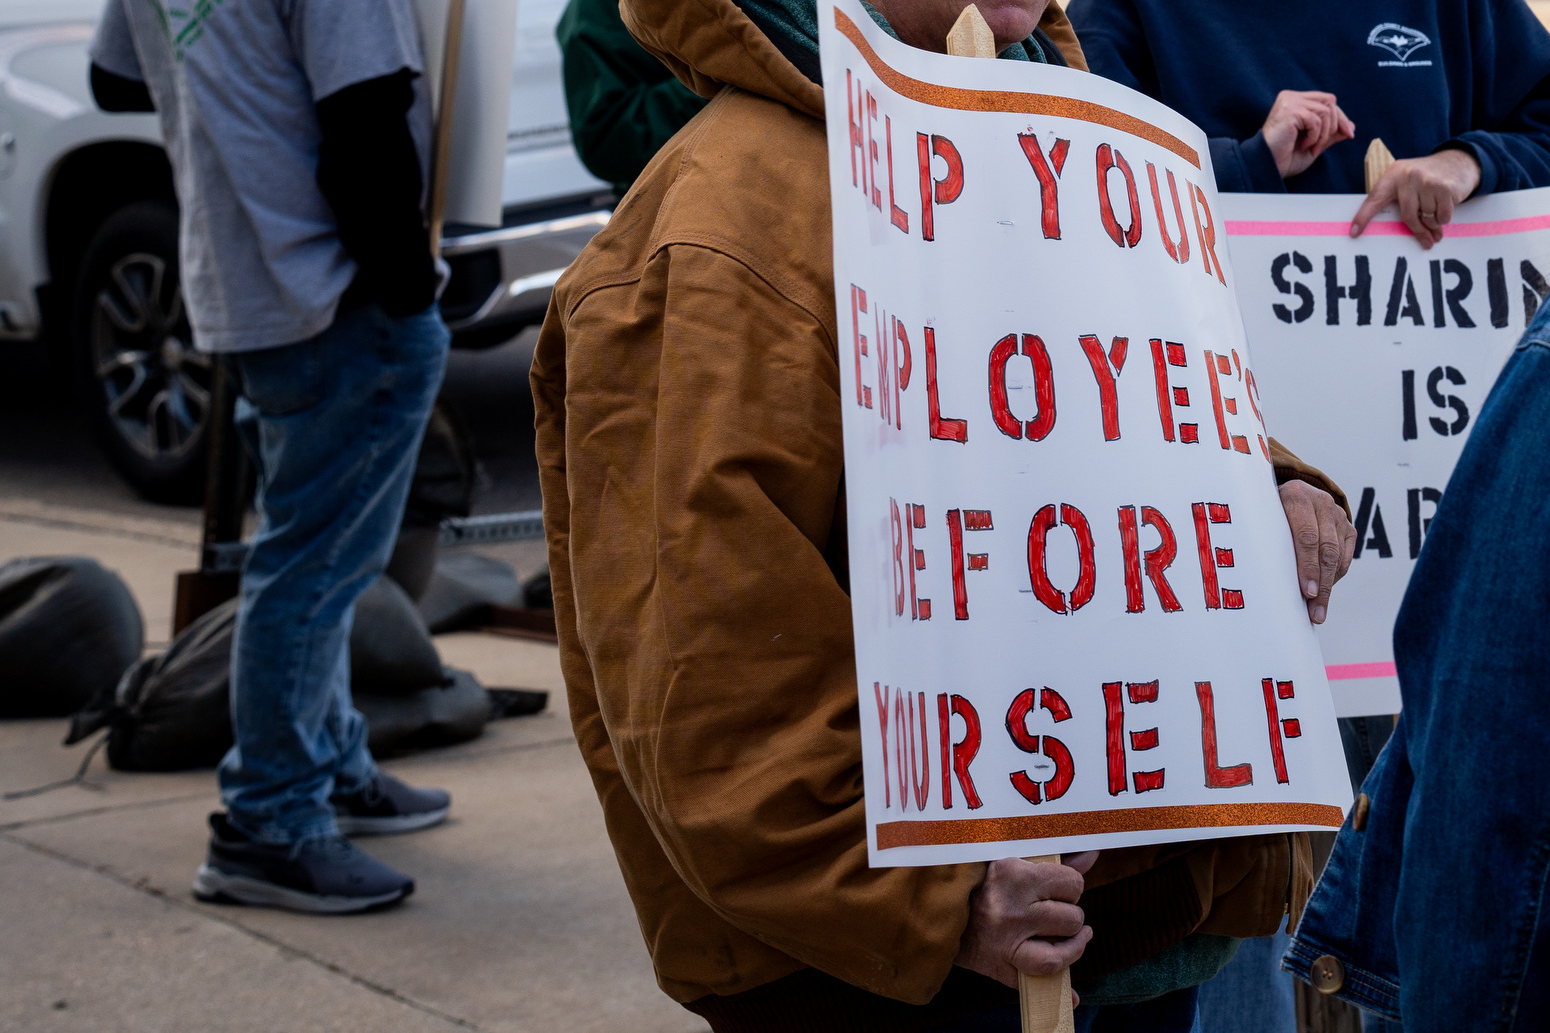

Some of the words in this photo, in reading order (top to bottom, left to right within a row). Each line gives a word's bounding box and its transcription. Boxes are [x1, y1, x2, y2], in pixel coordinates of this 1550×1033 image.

[847, 68, 965, 242] HELP
[1018, 131, 1228, 287] YOUR
[850, 283, 1272, 464] EMPLOYEE'S
[1402, 365, 1470, 442] IS
[889, 496, 1245, 620] BEFORE
[873, 678, 1303, 813] YOURSELF
